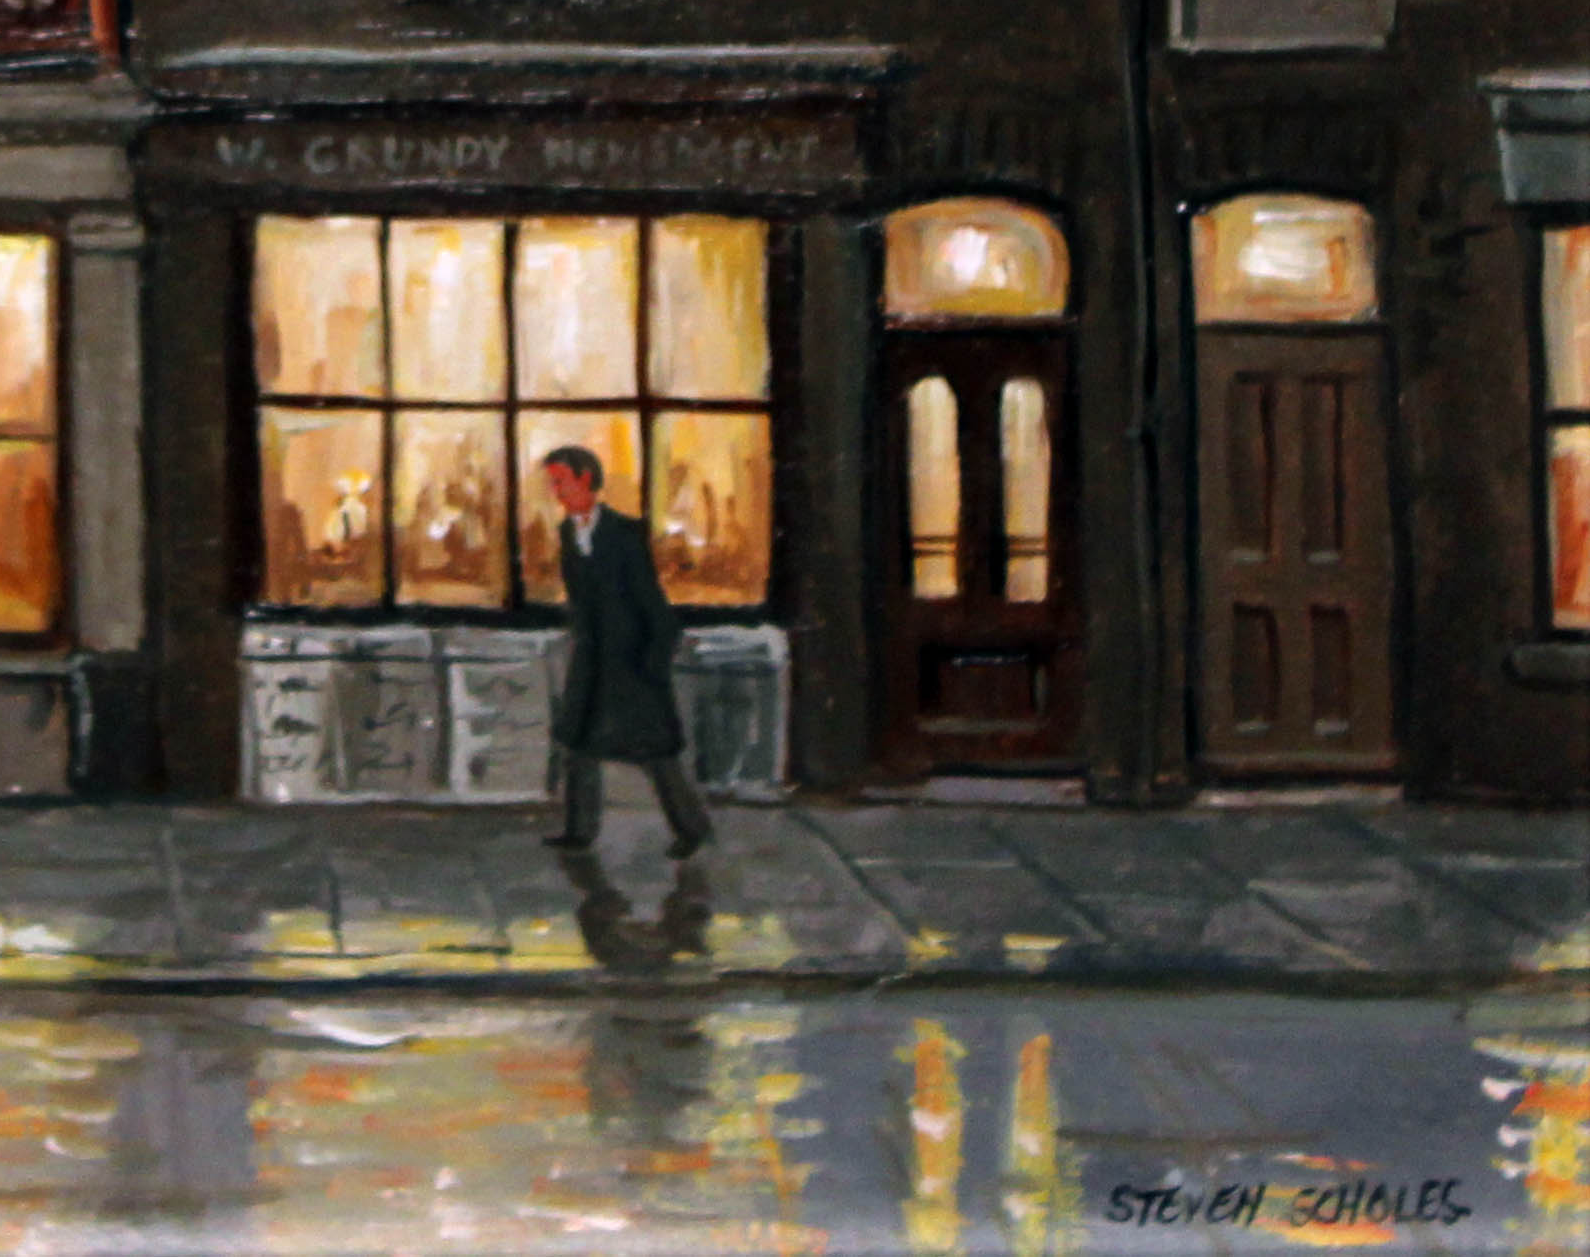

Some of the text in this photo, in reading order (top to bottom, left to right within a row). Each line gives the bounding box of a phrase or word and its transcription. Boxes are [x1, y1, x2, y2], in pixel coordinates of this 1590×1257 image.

[303, 135, 512, 176] GRUNDY
[1108, 1177, 1473, 1229] STEVEN SCHOLES
